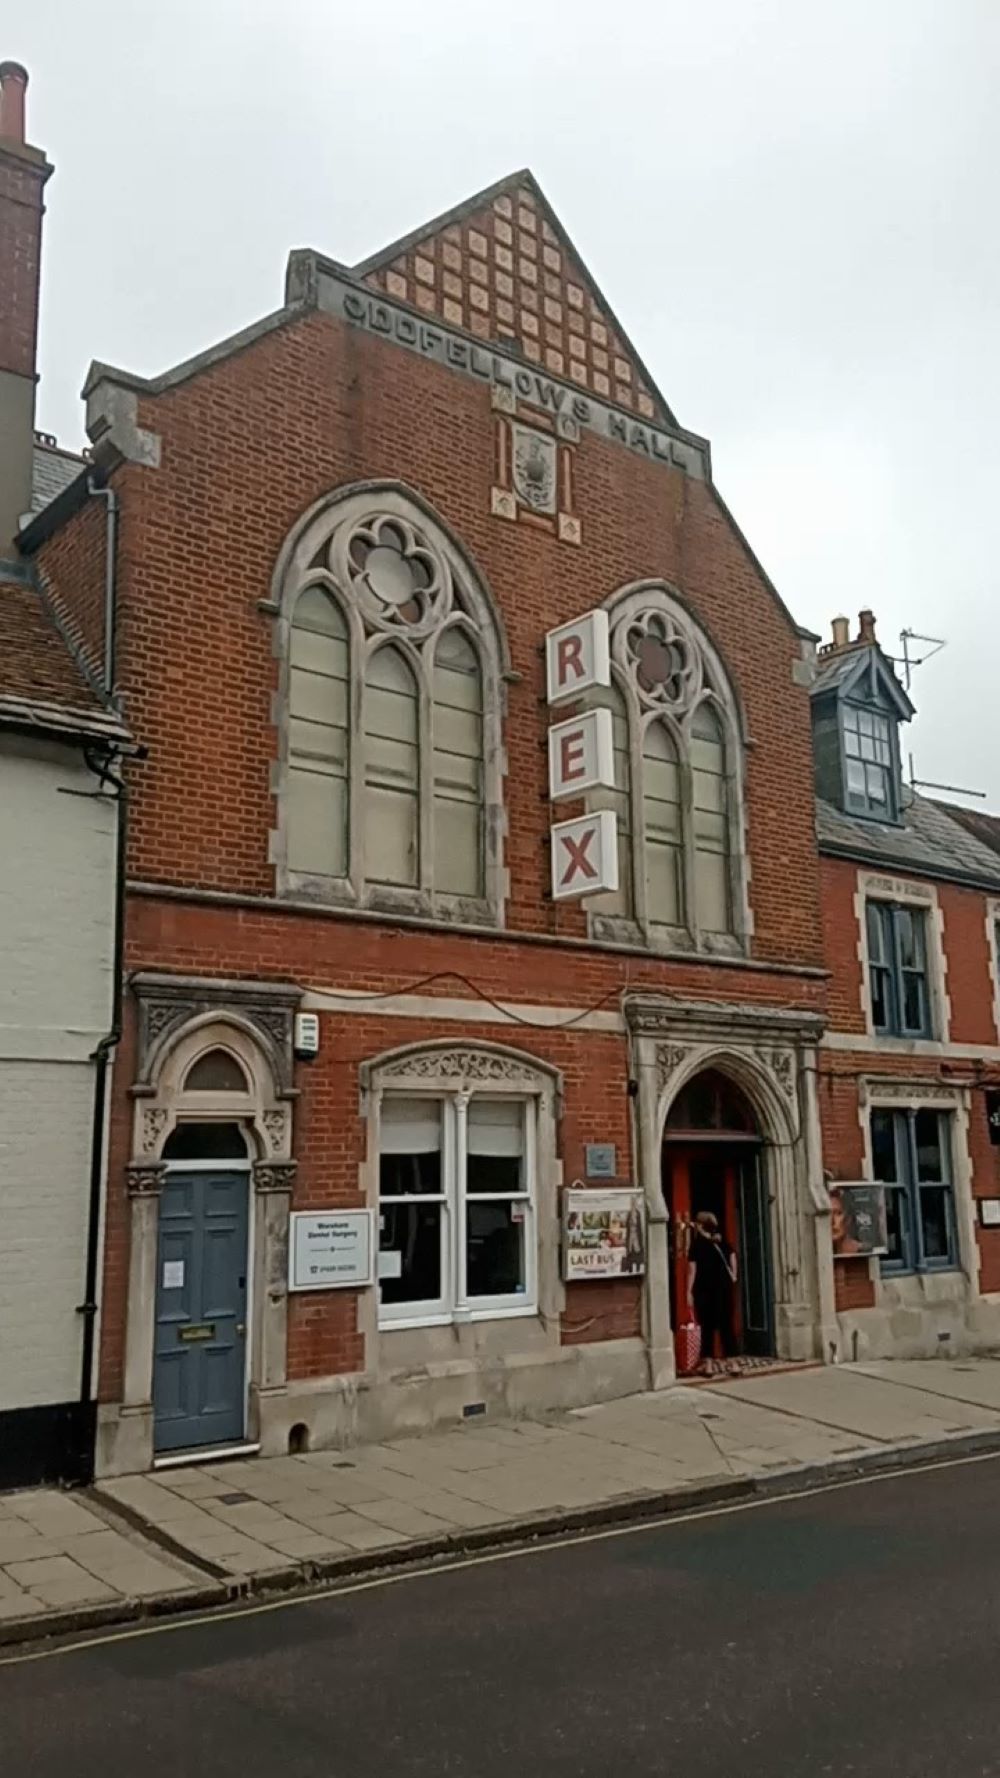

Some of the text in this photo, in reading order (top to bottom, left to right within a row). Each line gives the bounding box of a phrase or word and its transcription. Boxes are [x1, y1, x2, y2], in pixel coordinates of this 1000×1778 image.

[608, 411, 688, 471] HALL
[308, 1230, 358, 1239] Dental Surgery
[571, 1253, 594, 1266] LAST
